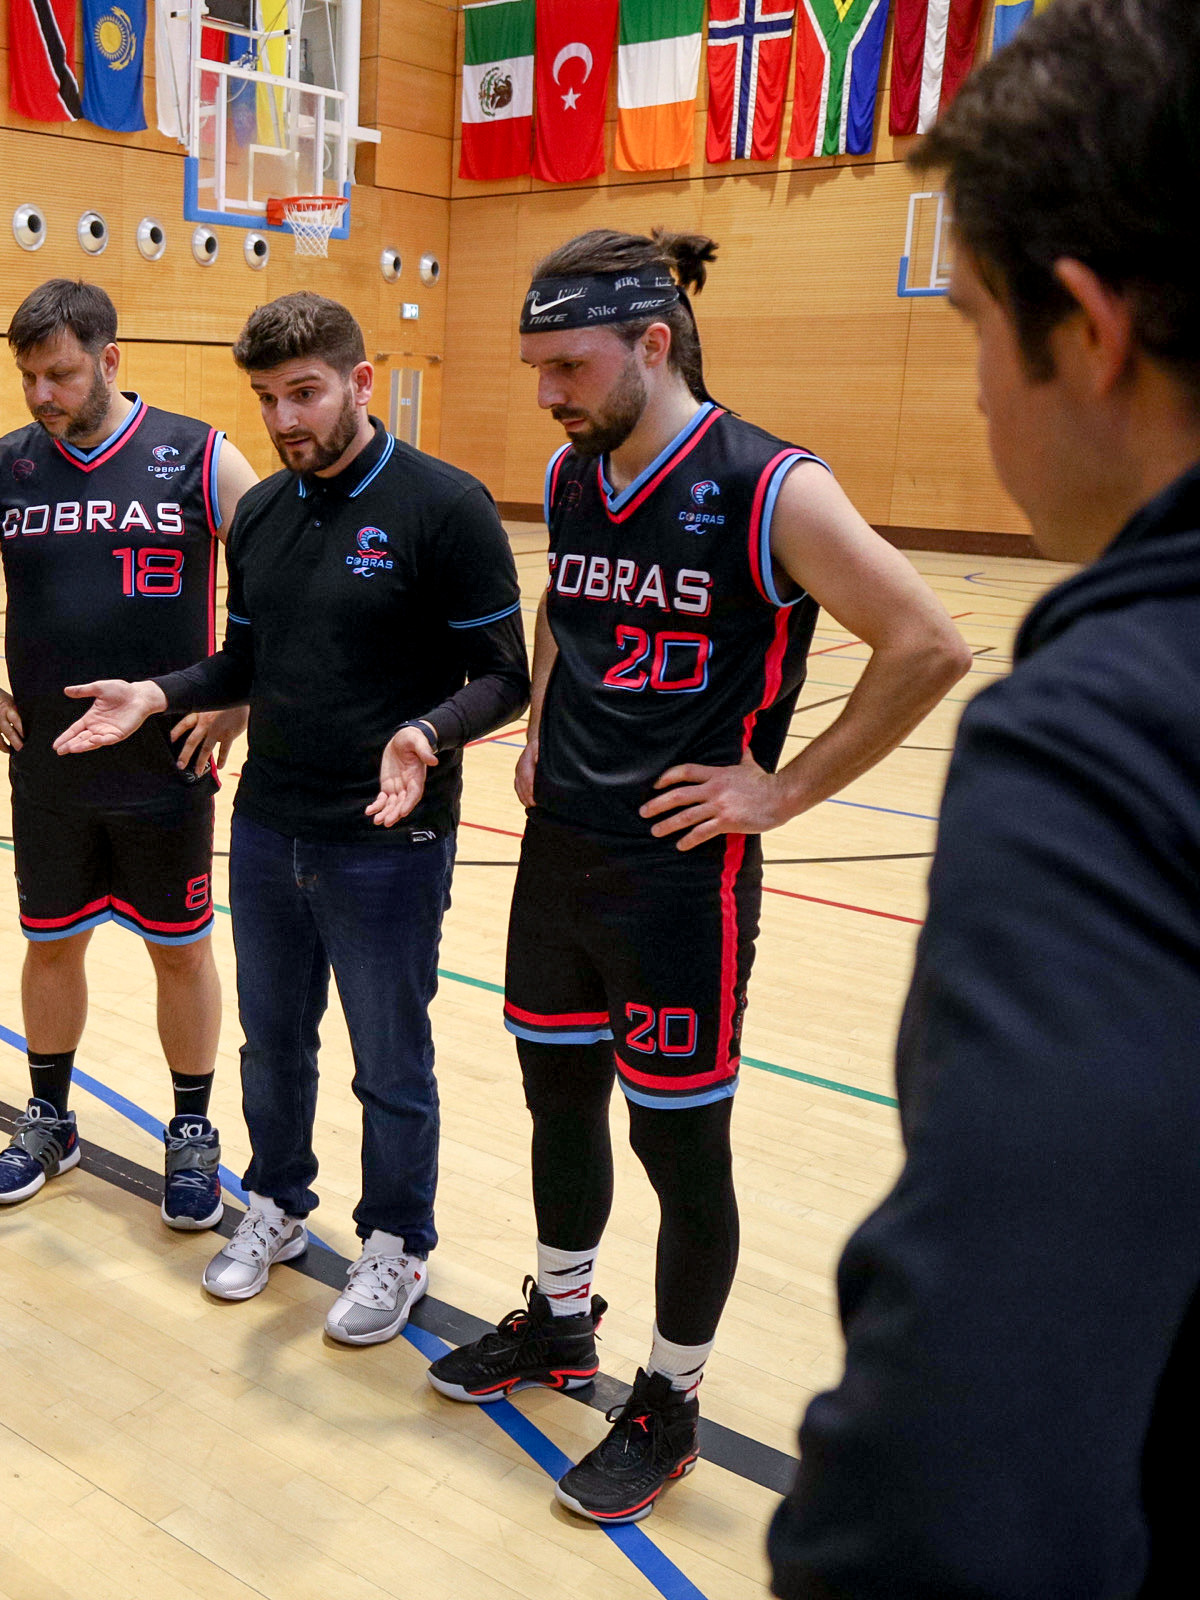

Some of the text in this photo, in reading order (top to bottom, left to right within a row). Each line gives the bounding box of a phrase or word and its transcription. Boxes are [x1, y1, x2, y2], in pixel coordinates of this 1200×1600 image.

[147, 464, 187, 474] COBRAS
[2, 499, 186, 539] COBRAS
[678, 510, 726, 525] COBRAS
[112, 546, 185, 598] 18
[345, 554, 394, 570] COBRAS
[602, 624, 714, 695] 20
[625, 1002, 698, 1057] 20
